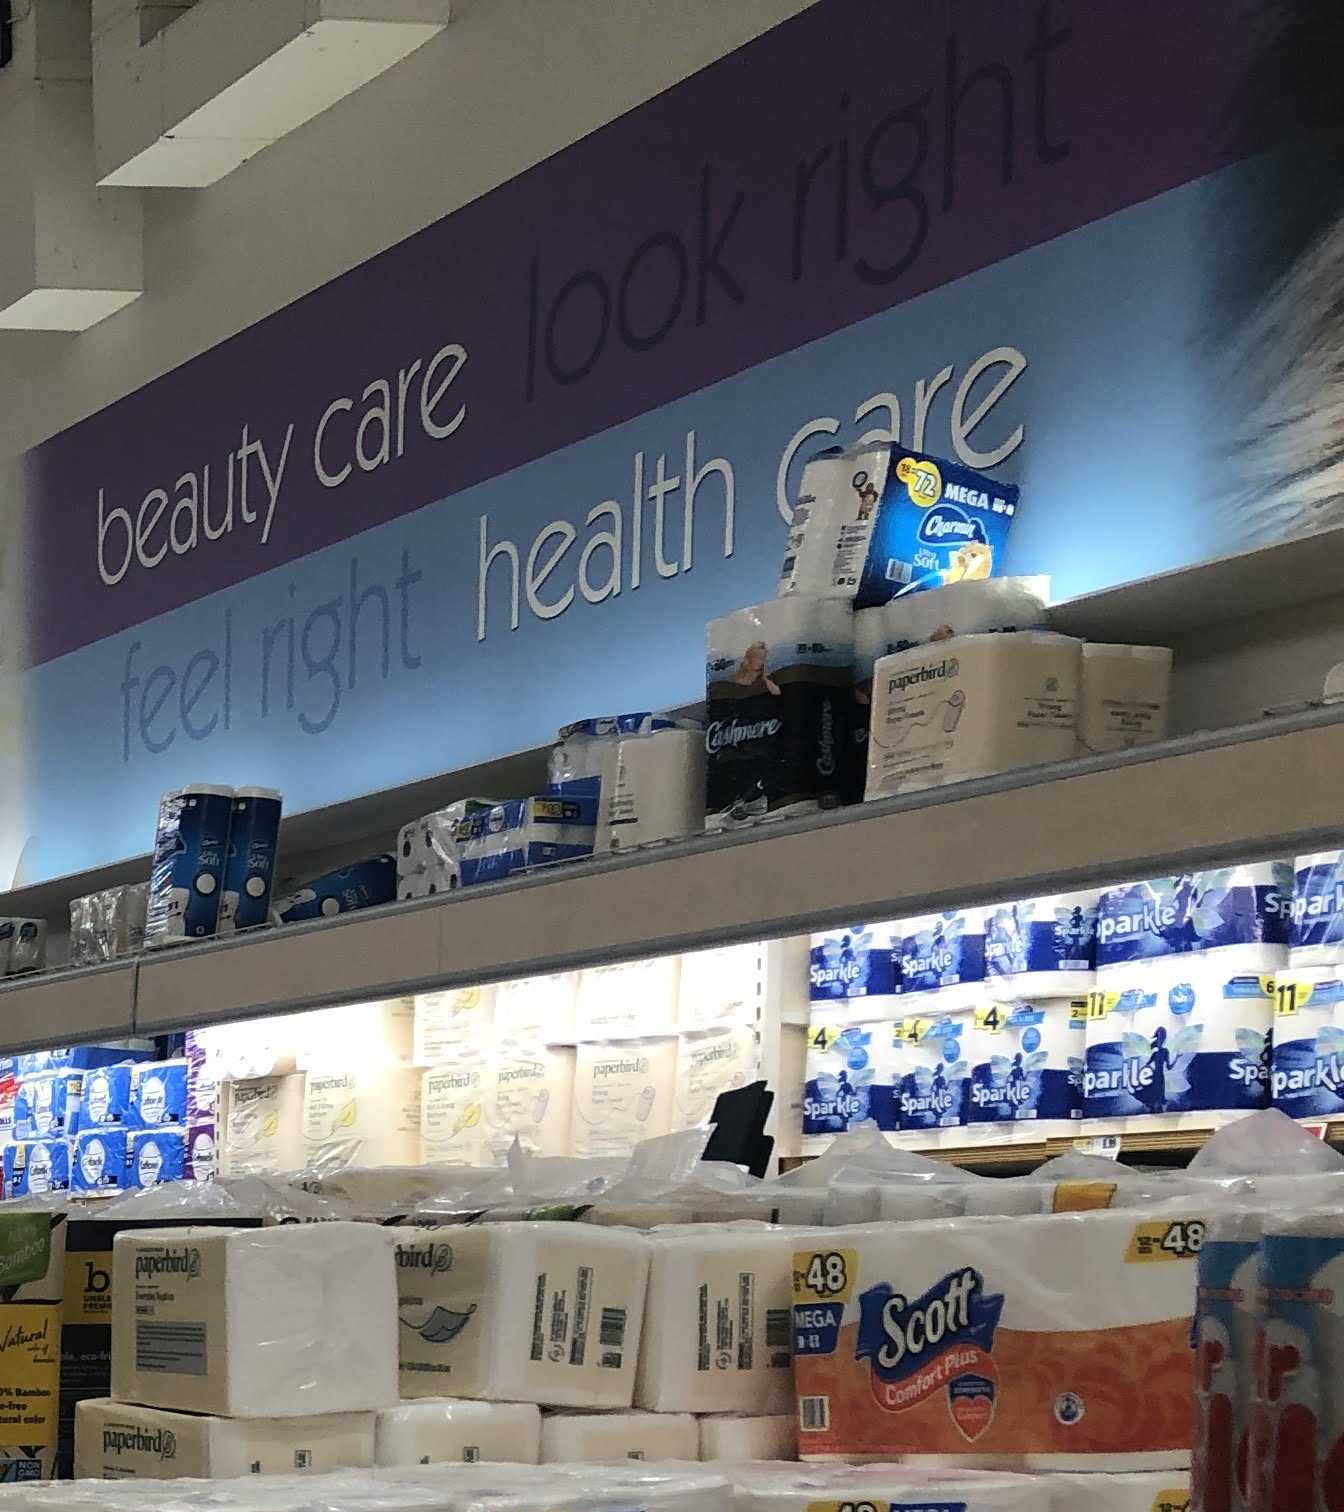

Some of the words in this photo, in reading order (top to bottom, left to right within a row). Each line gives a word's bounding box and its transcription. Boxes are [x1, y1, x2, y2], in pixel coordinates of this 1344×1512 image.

[97, 420, 293, 585] beauty
[312, 342, 467, 487] care
[525, 164, 748, 401] look
[792, 17, 1072, 285] right
[914, 469, 936, 496] 72
[945, 483, 990, 511] MEGA
[117, 619, 233, 763] feel
[262, 545, 423, 733] right
[475, 428, 734, 641] health
[888, 660, 946, 693] paperbird
[706, 716, 783, 755] Cashmere
[810, 962, 860, 986] Sparkle
[902, 951, 952, 977] Sparkle
[593, 1057, 639, 1079] paperbird
[428, 1073, 471, 1094] paperbird
[971, 1080, 1031, 1109] Sparkle
[804, 1094, 861, 1122] Sparkle
[900, 1091, 952, 1118] Sparkle
[1162, 1221, 1206, 1253] 48
[135, 1252, 191, 1281] paperbird
[807, 1252, 846, 1293] 48
[878, 1268, 975, 1370] Scott
[15, 1386, 52, 1398] Bamboo
[885, 1367, 943, 1406] Comfort
[944, 1349, 978, 1376] Plus
[102, 1427, 164, 1455] paperbird
